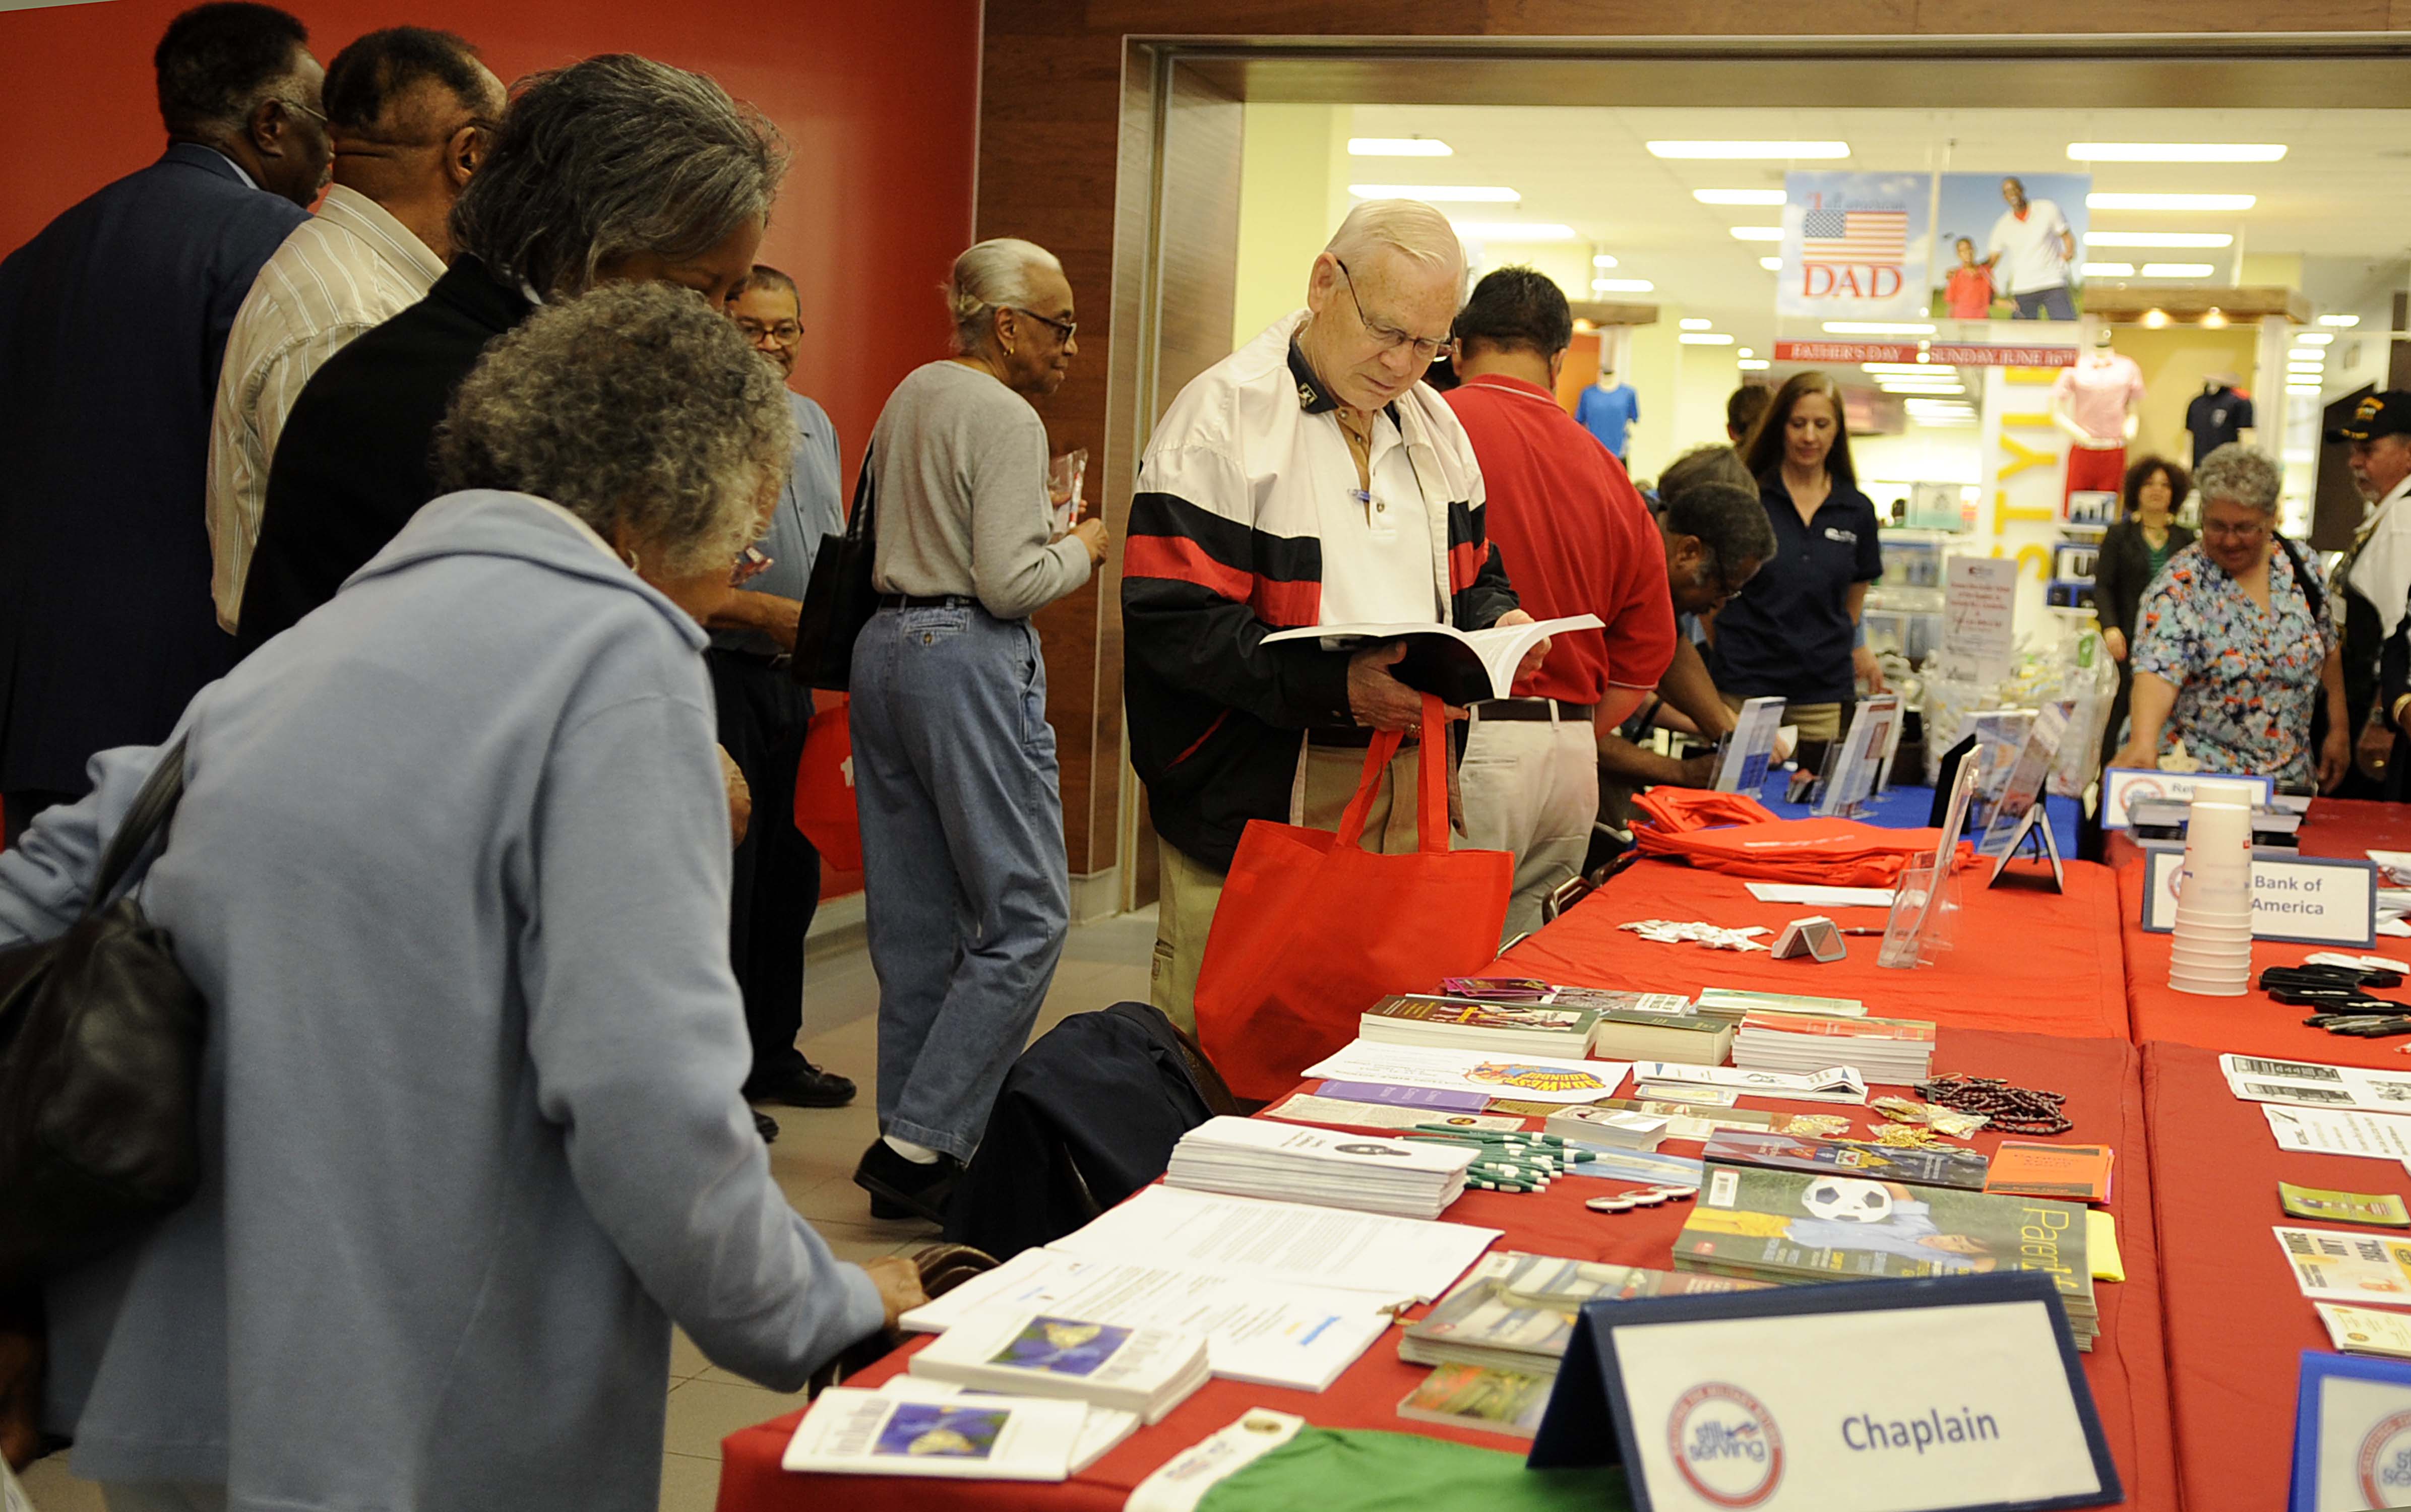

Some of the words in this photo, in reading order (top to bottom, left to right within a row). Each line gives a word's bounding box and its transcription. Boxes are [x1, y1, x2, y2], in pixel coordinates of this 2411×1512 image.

[1803, 264, 1903, 299] DAD
[2255, 875, 2298, 890] Bank
[2304, 878, 2323, 892] of
[2251, 897, 2324, 915] America
[1842, 1406, 2000, 1455] Chaplain
